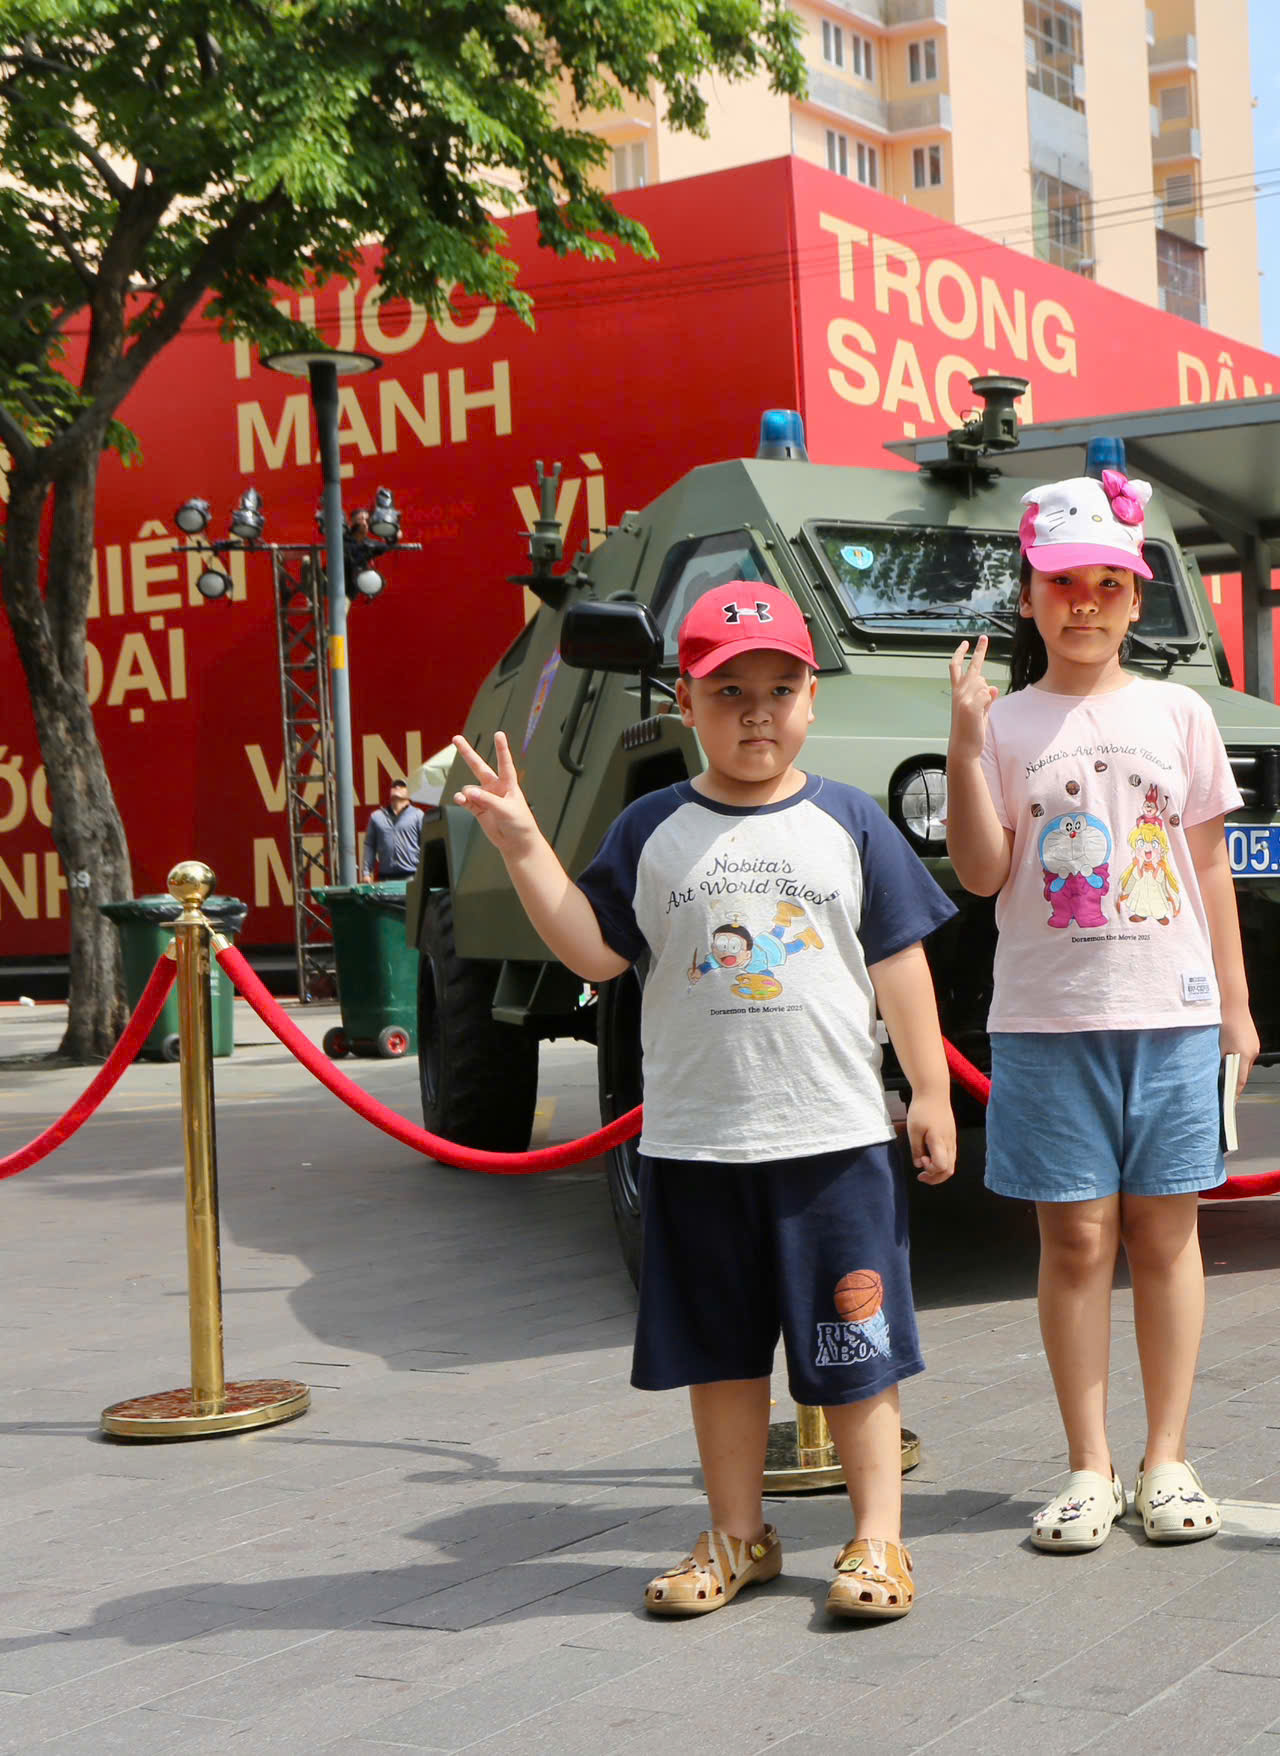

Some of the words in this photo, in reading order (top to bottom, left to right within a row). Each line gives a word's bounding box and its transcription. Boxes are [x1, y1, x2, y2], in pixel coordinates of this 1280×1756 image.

[819, 211, 1077, 377] TRONG
[237, 360, 512, 479] MẠNH
[1096, 744, 1136, 755] World
[706, 853, 794, 877] Nobita's
[665, 887, 697, 914] Art
[700, 877, 771, 896] World
[775, 878, 830, 905] Tales
[710, 1007, 746, 1016] Doraemon
